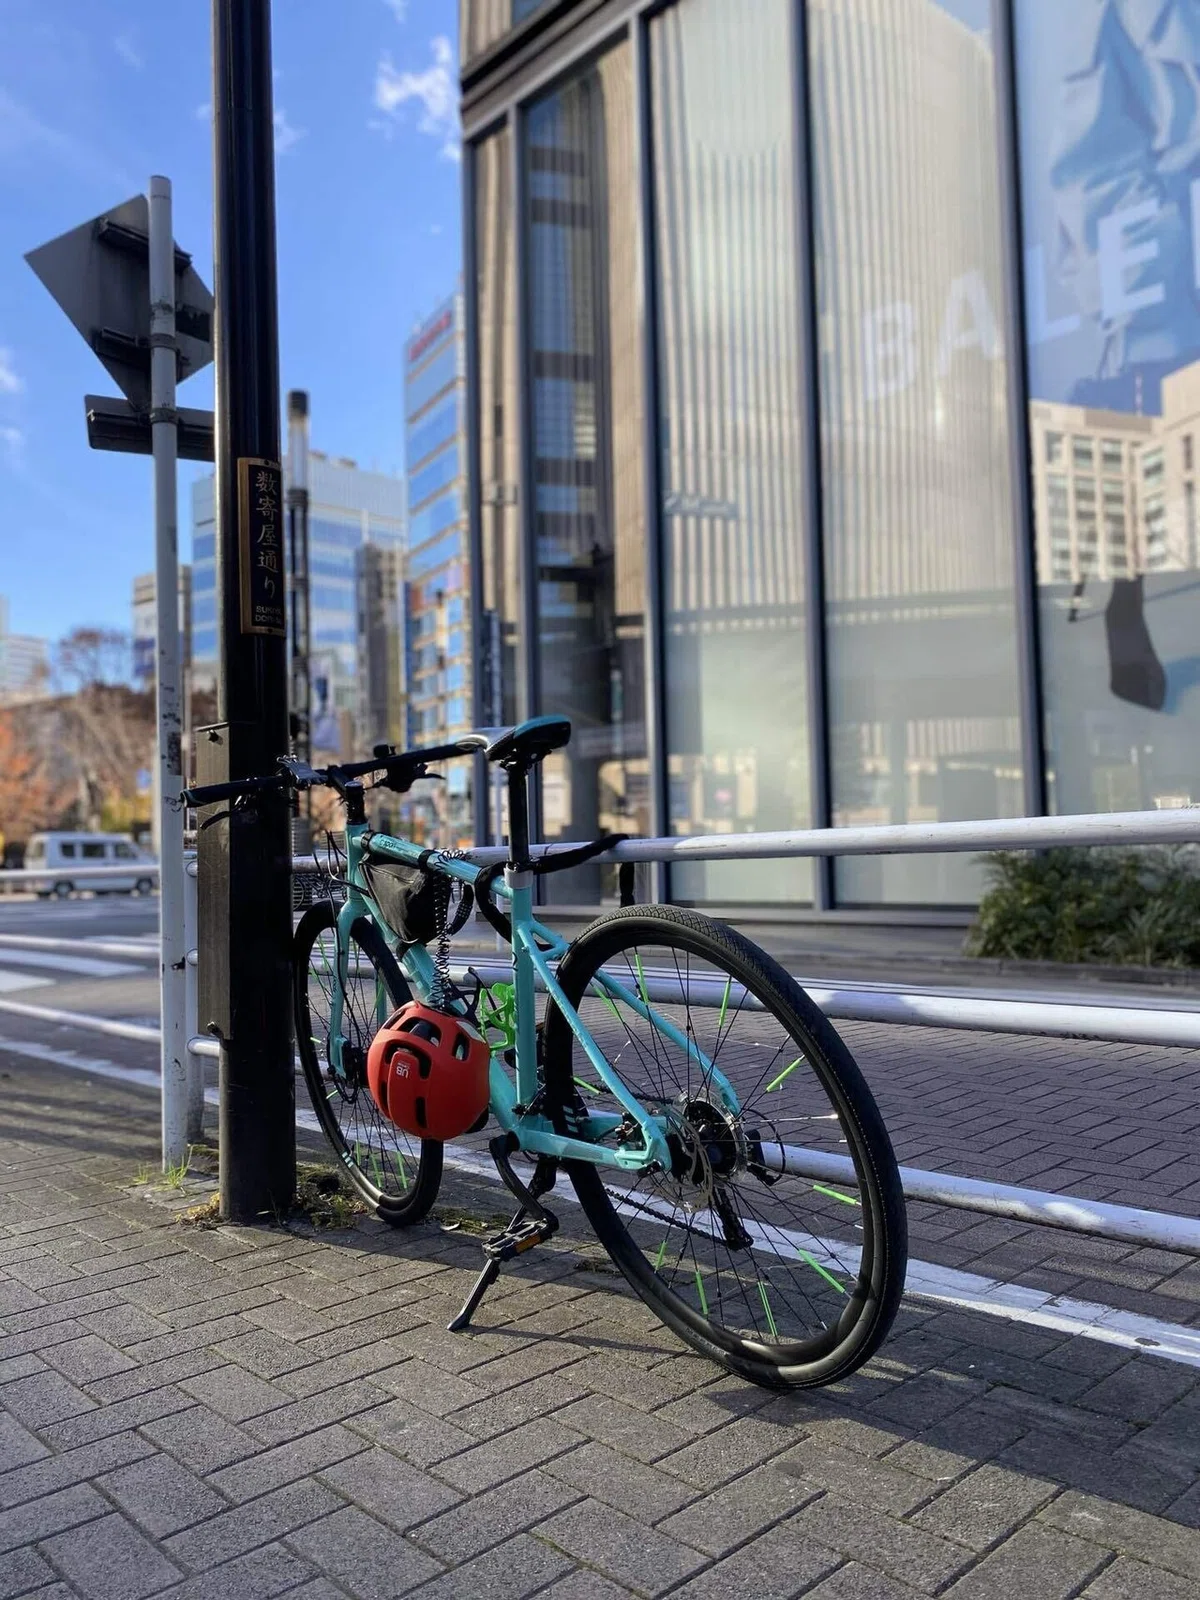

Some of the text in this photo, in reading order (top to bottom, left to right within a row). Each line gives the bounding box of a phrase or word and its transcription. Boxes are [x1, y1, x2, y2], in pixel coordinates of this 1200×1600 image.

[862, 179, 1200, 402] BALE
[255, 470, 279, 599] 数寄屋通り
